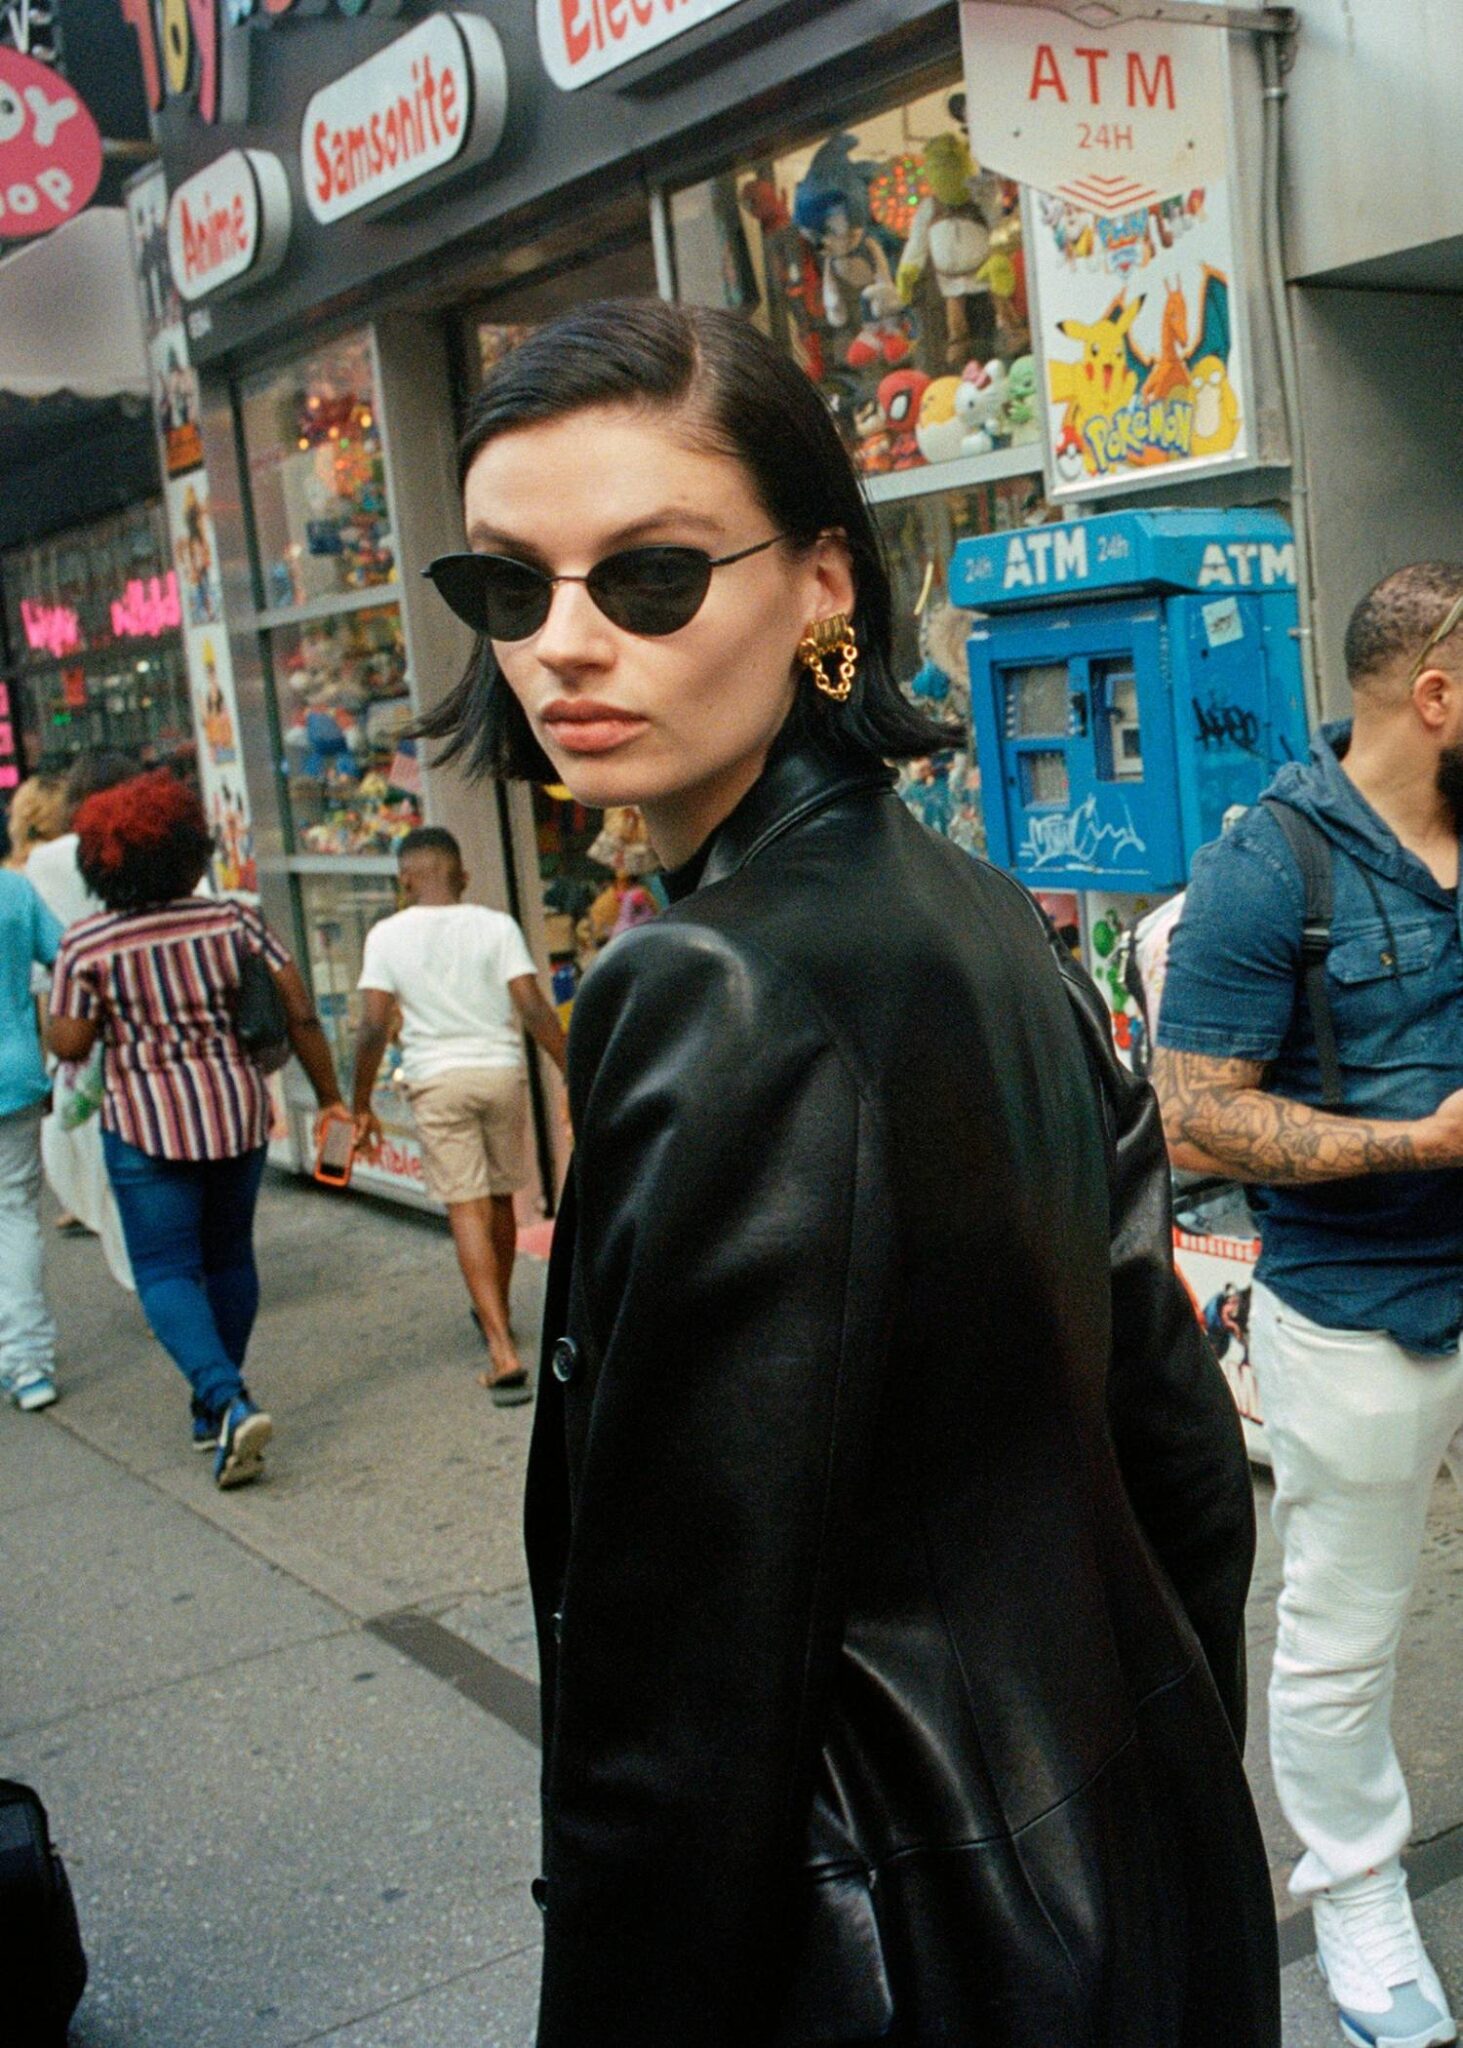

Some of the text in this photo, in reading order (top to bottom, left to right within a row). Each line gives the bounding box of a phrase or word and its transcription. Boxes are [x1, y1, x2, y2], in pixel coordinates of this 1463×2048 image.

[1029, 44, 1175, 110] ATM
[313, 55, 460, 203] Samsonite
[1077, 122, 1134, 150] 24H
[180, 190, 249, 281] Anime
[1003, 526, 1088, 590] ATM
[1197, 542, 1298, 588] ATM
